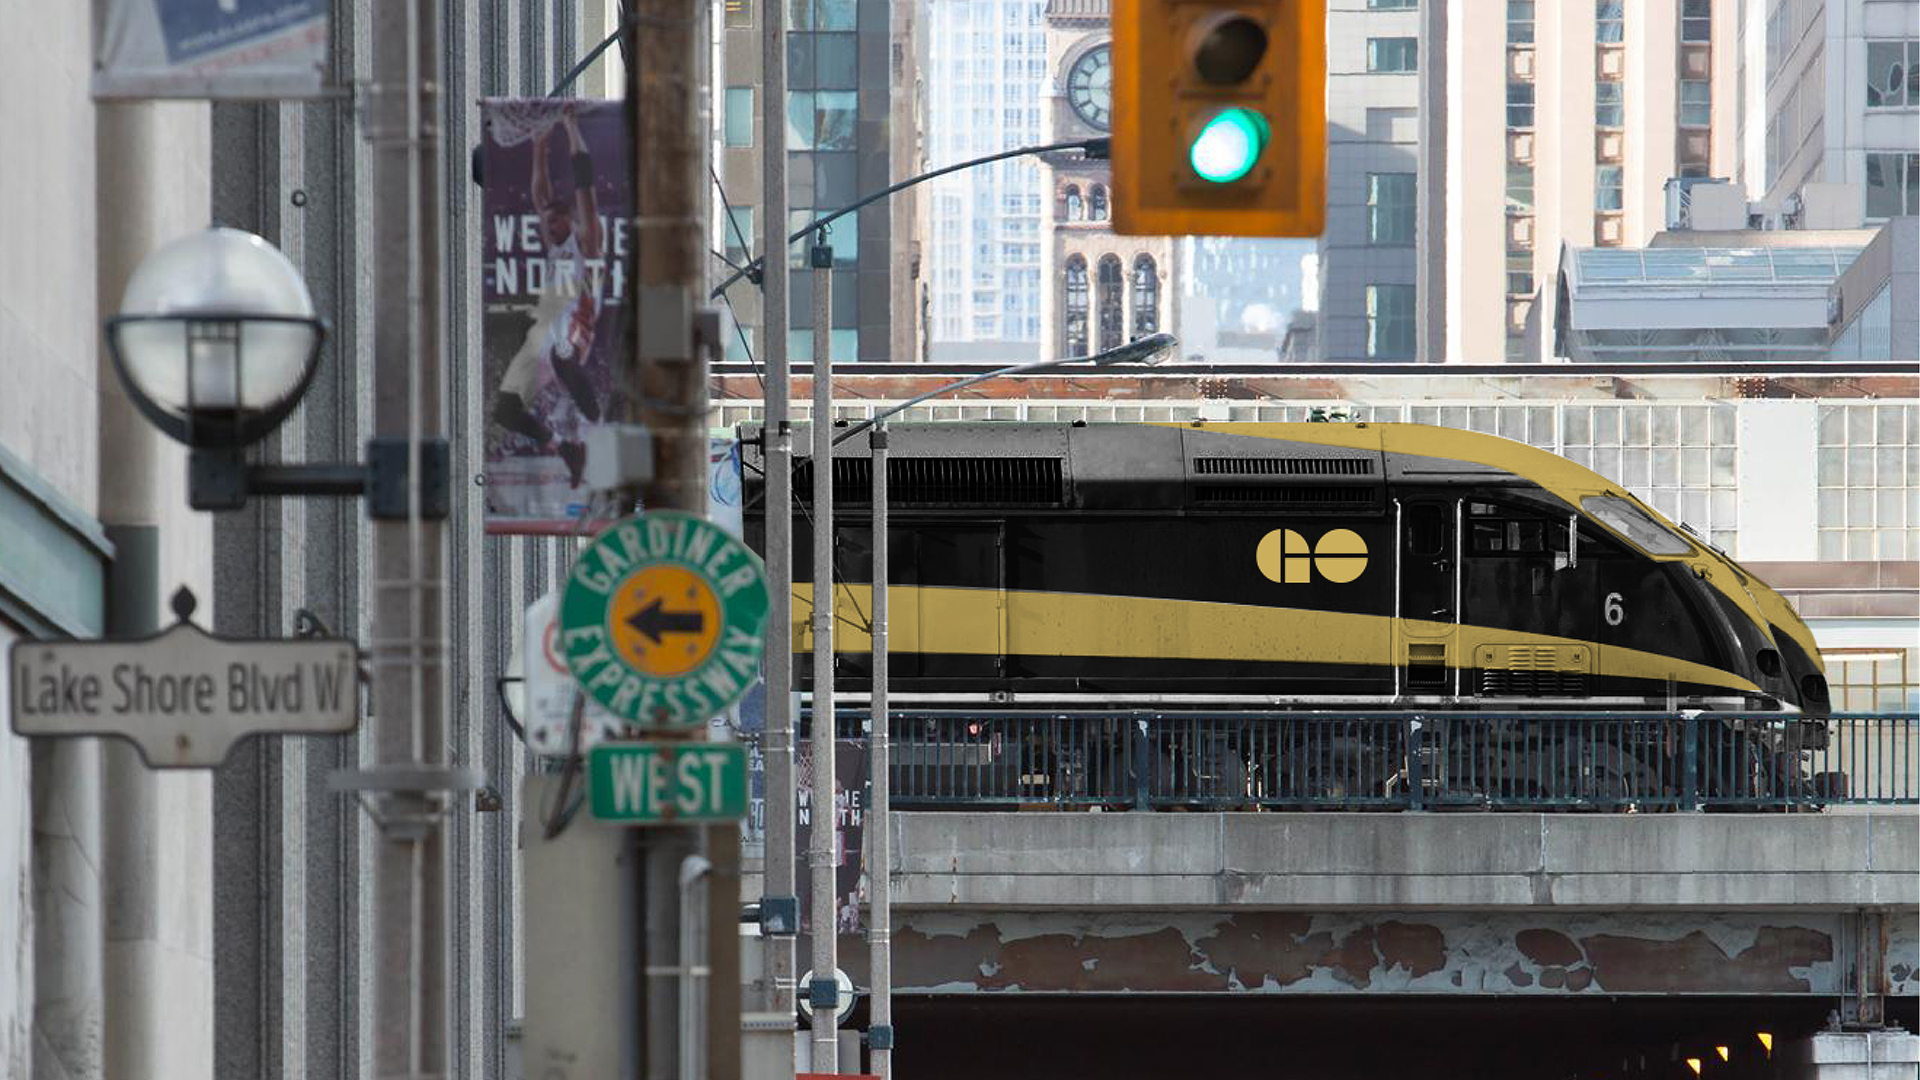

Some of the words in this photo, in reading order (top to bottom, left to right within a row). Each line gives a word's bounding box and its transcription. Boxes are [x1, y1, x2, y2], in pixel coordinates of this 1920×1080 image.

[575, 519, 756, 596] GARDINER
[1256, 528, 1369, 583] GO
[1604, 592, 1624, 626] 6
[21, 663, 101, 715] Lake
[112, 663, 214, 715] Shore
[227, 662, 303, 714] Blvd
[313, 663, 344, 712] W
[564, 624, 762, 720] EXPRESSWAY
[609, 752, 729, 813] WEST
[799, 808, 861, 826] NTH
